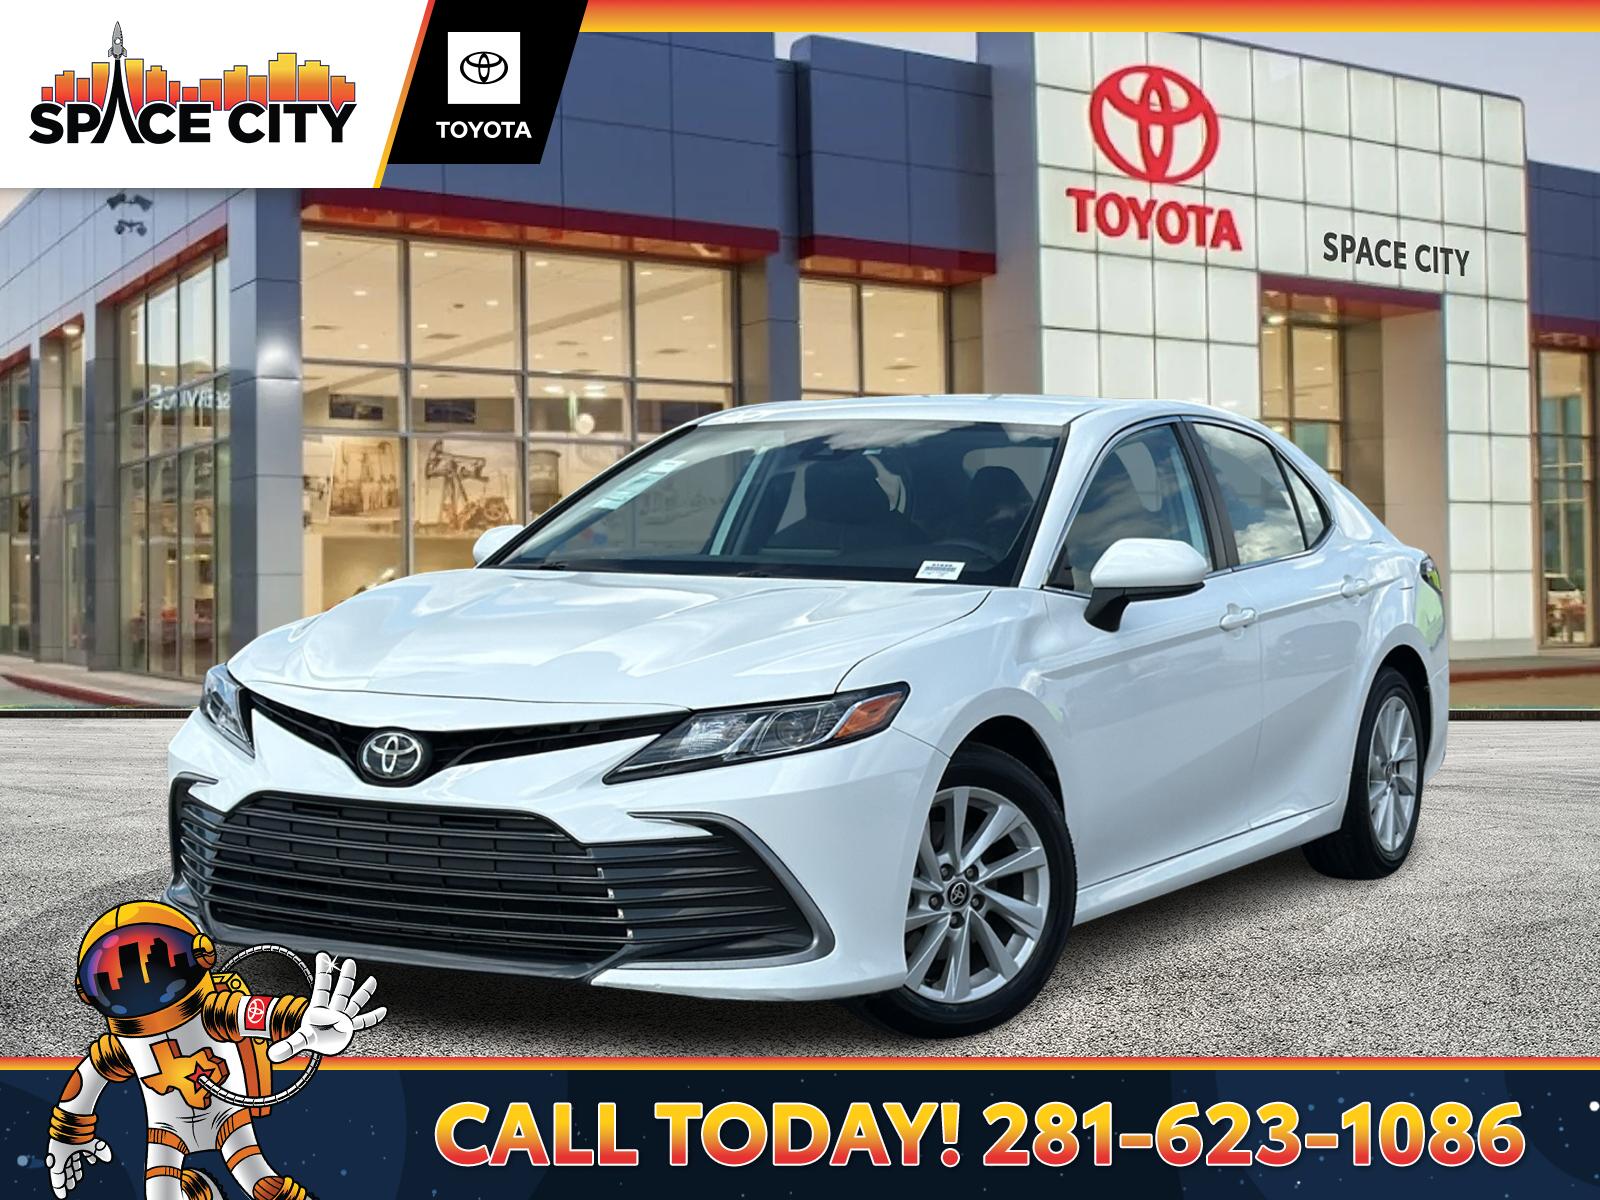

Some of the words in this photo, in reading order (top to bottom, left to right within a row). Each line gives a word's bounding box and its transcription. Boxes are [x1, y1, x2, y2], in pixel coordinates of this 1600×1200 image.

[1066, 187, 1243, 252] TOYOTA
[1323, 232, 1407, 270] SPACE
[1415, 244, 1470, 277] CITY
